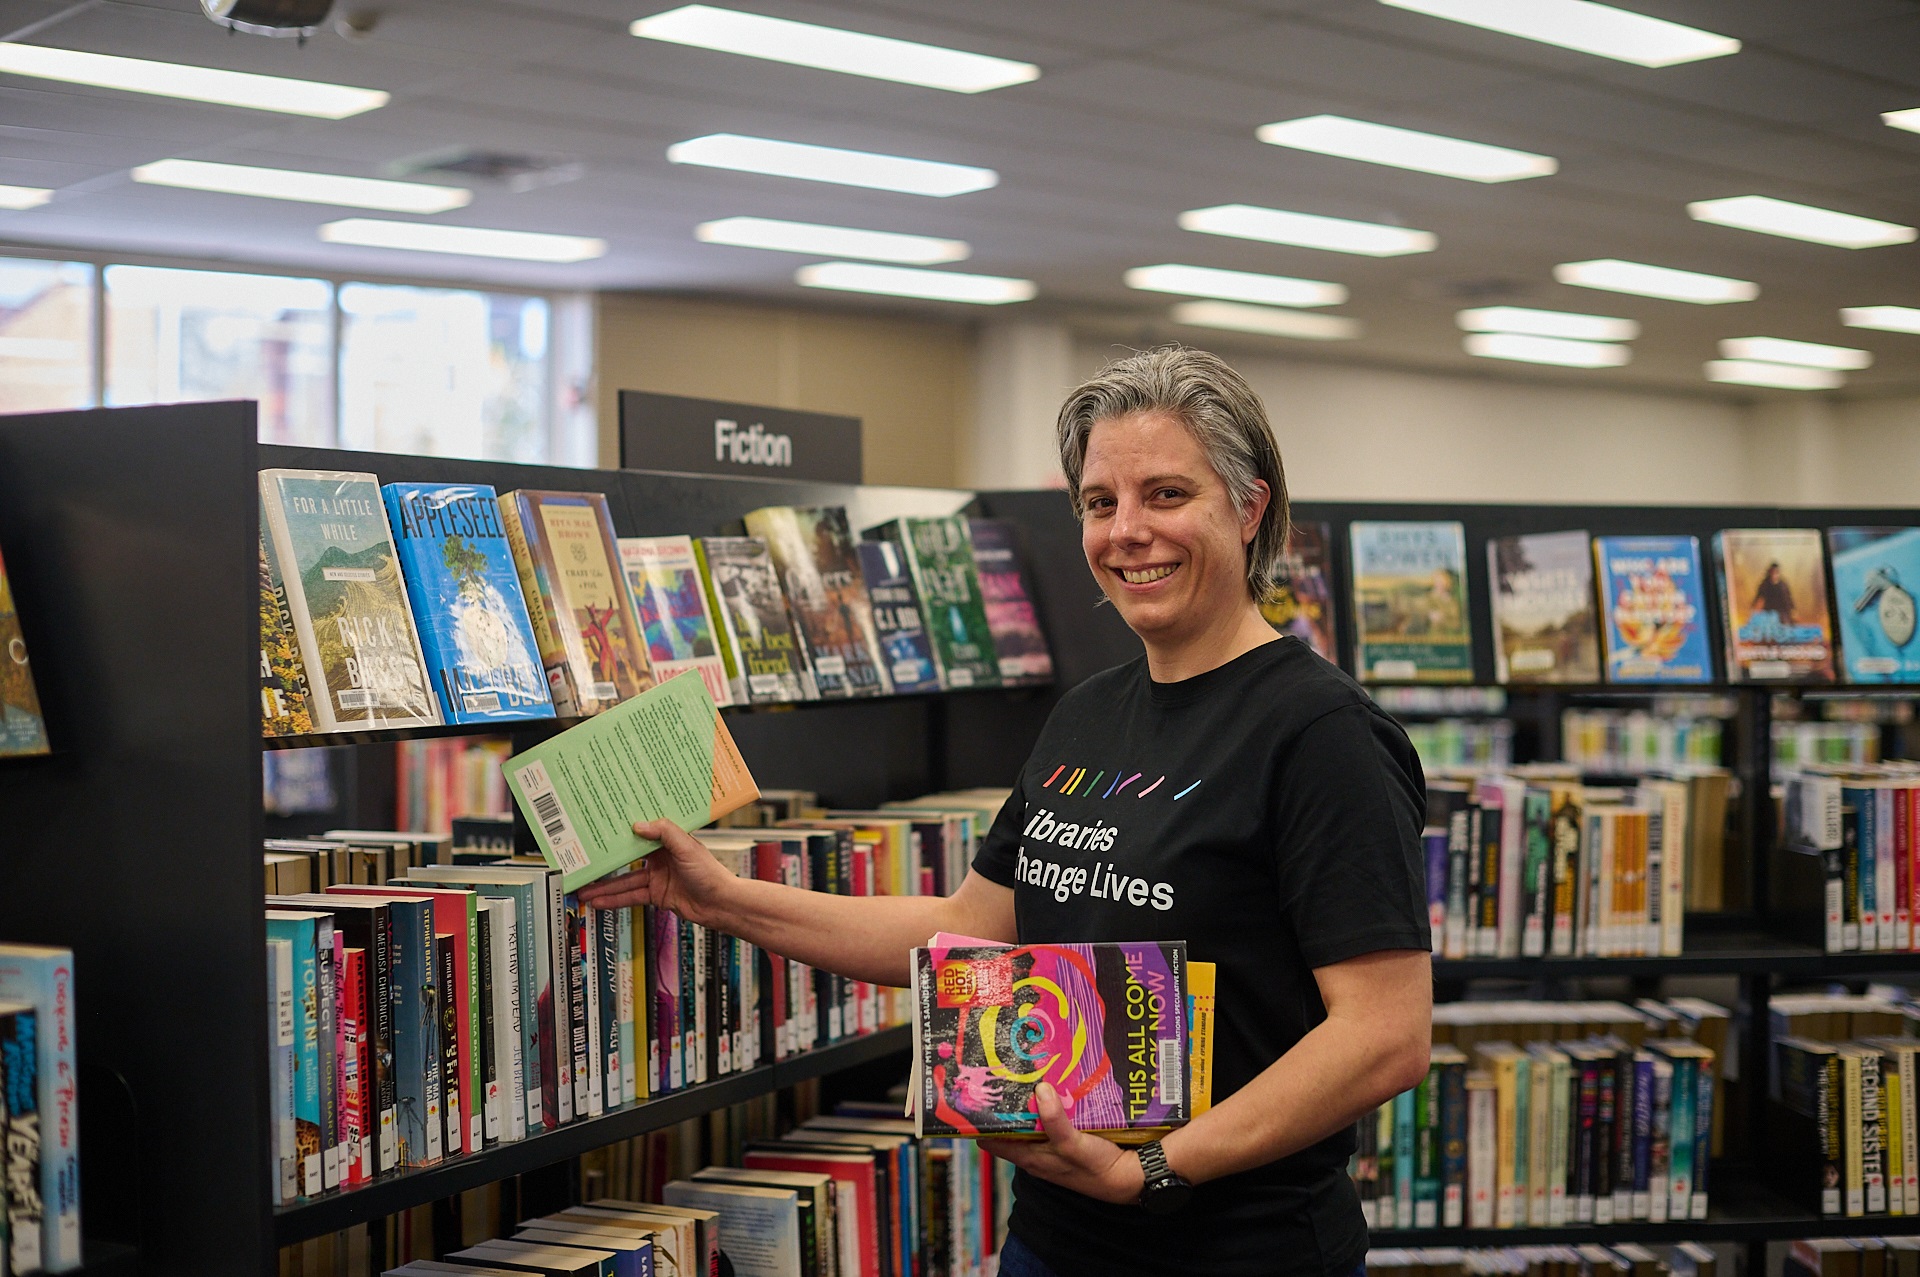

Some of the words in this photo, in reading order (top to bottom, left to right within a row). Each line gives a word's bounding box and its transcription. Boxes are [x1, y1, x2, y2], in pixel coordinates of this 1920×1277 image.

[715, 419, 792, 468] Fiction
[293, 496, 318, 514] FOR
[322, 498, 330, 514] A
[332, 498, 372, 516] LITTLE
[320, 523, 358, 541] WHILE
[338, 616, 394, 648] RICK
[345, 656, 405, 688] BASS
[1023, 803, 1118, 851] ibraries
[1014, 846, 1088, 902] hange
[1090, 862, 1174, 911] Lives
[377, 933, 386, 974] MEDUSA
[508, 924, 518, 974] PRETEND
[571, 946, 580, 964] TAKE
[605, 947, 617, 992] LAND
[320, 949, 330, 1032] SUSPECT
[334, 958, 344, 1000] Diksha
[357, 955, 365, 1026] PAPERCUTS
[572, 966, 581, 987] BACK
[921, 974, 932, 1020] SAUNDERS
[944, 969, 955, 996] RED
[956, 968, 967, 996] HOT
[1126, 952, 1145, 1021] COME
[302, 958, 318, 1052] FORTUNE
[336, 1002, 344, 1034] Basu
[378, 976, 388, 1040] CHRONICLES
[512, 1000, 521, 1032] DEAD
[573, 990, 582, 1005] THE
[574, 1008, 584, 1021] SKY
[1148, 970, 1166, 1030] NOW
[513, 1046, 522, 1066] JEN
[924, 1024, 932, 1063] MYKAELA
[1128, 1025, 1146, 1066] ALL
[925, 1064, 932, 1076] BY
[1862, 1055, 1879, 1122] SECOND
[1129, 1072, 1147, 1120] THIS
[1178, 1108, 1183, 1119] AN
